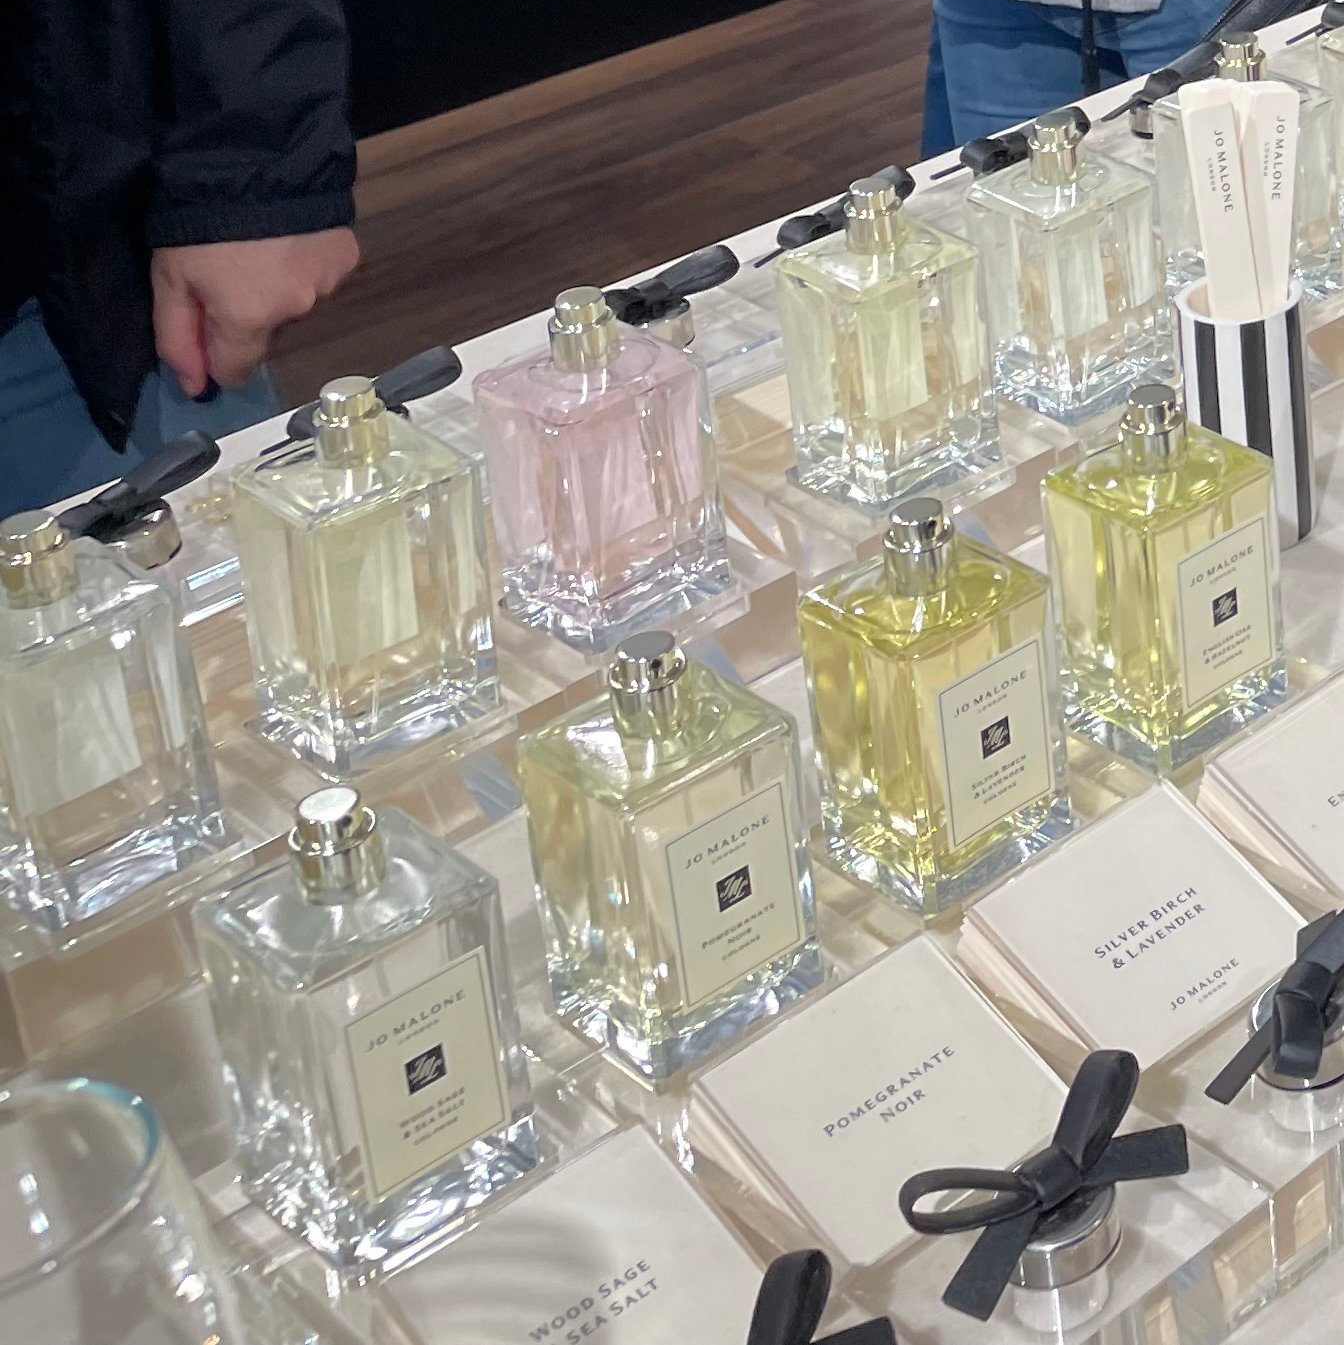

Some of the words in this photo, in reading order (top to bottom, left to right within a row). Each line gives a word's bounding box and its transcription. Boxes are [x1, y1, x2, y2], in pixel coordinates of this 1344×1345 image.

[1214, 129, 1224, 147] JO
[1276, 115, 1286, 134] JO
[1216, 151, 1234, 213] MALONE
[1271, 138, 1285, 201] MALONE
[1190, 573, 1204, 588] JO
[1207, 545, 1254, 577] MALONE
[954, 703, 970, 719] JO
[973, 670, 1027, 705] MALONE
[684, 853, 703, 870] JO
[707, 814, 770, 855] MALONE
[701, 902, 775, 950] POMEGRANATE
[1094, 920, 1150, 959] SILVER
[1149, 887, 1197, 922] BIRCH
[1112, 957, 1126, 969] &
[1125, 903, 1206, 959] LAVENDER
[1170, 996, 1186, 1011] JO
[1186, 958, 1240, 997] MALONE
[366, 1033, 388, 1053] JO
[392, 989, 466, 1035] MALONE
[822, 1044, 956, 1139] POMEGRANATE
[879, 1088, 928, 1124] NOIR
[528, 1296, 595, 1343] WOOD
[598, 1259, 651, 1299] SAGE
[566, 1314, 609, 1345] SEA
[609, 1277, 658, 1317] SALT
